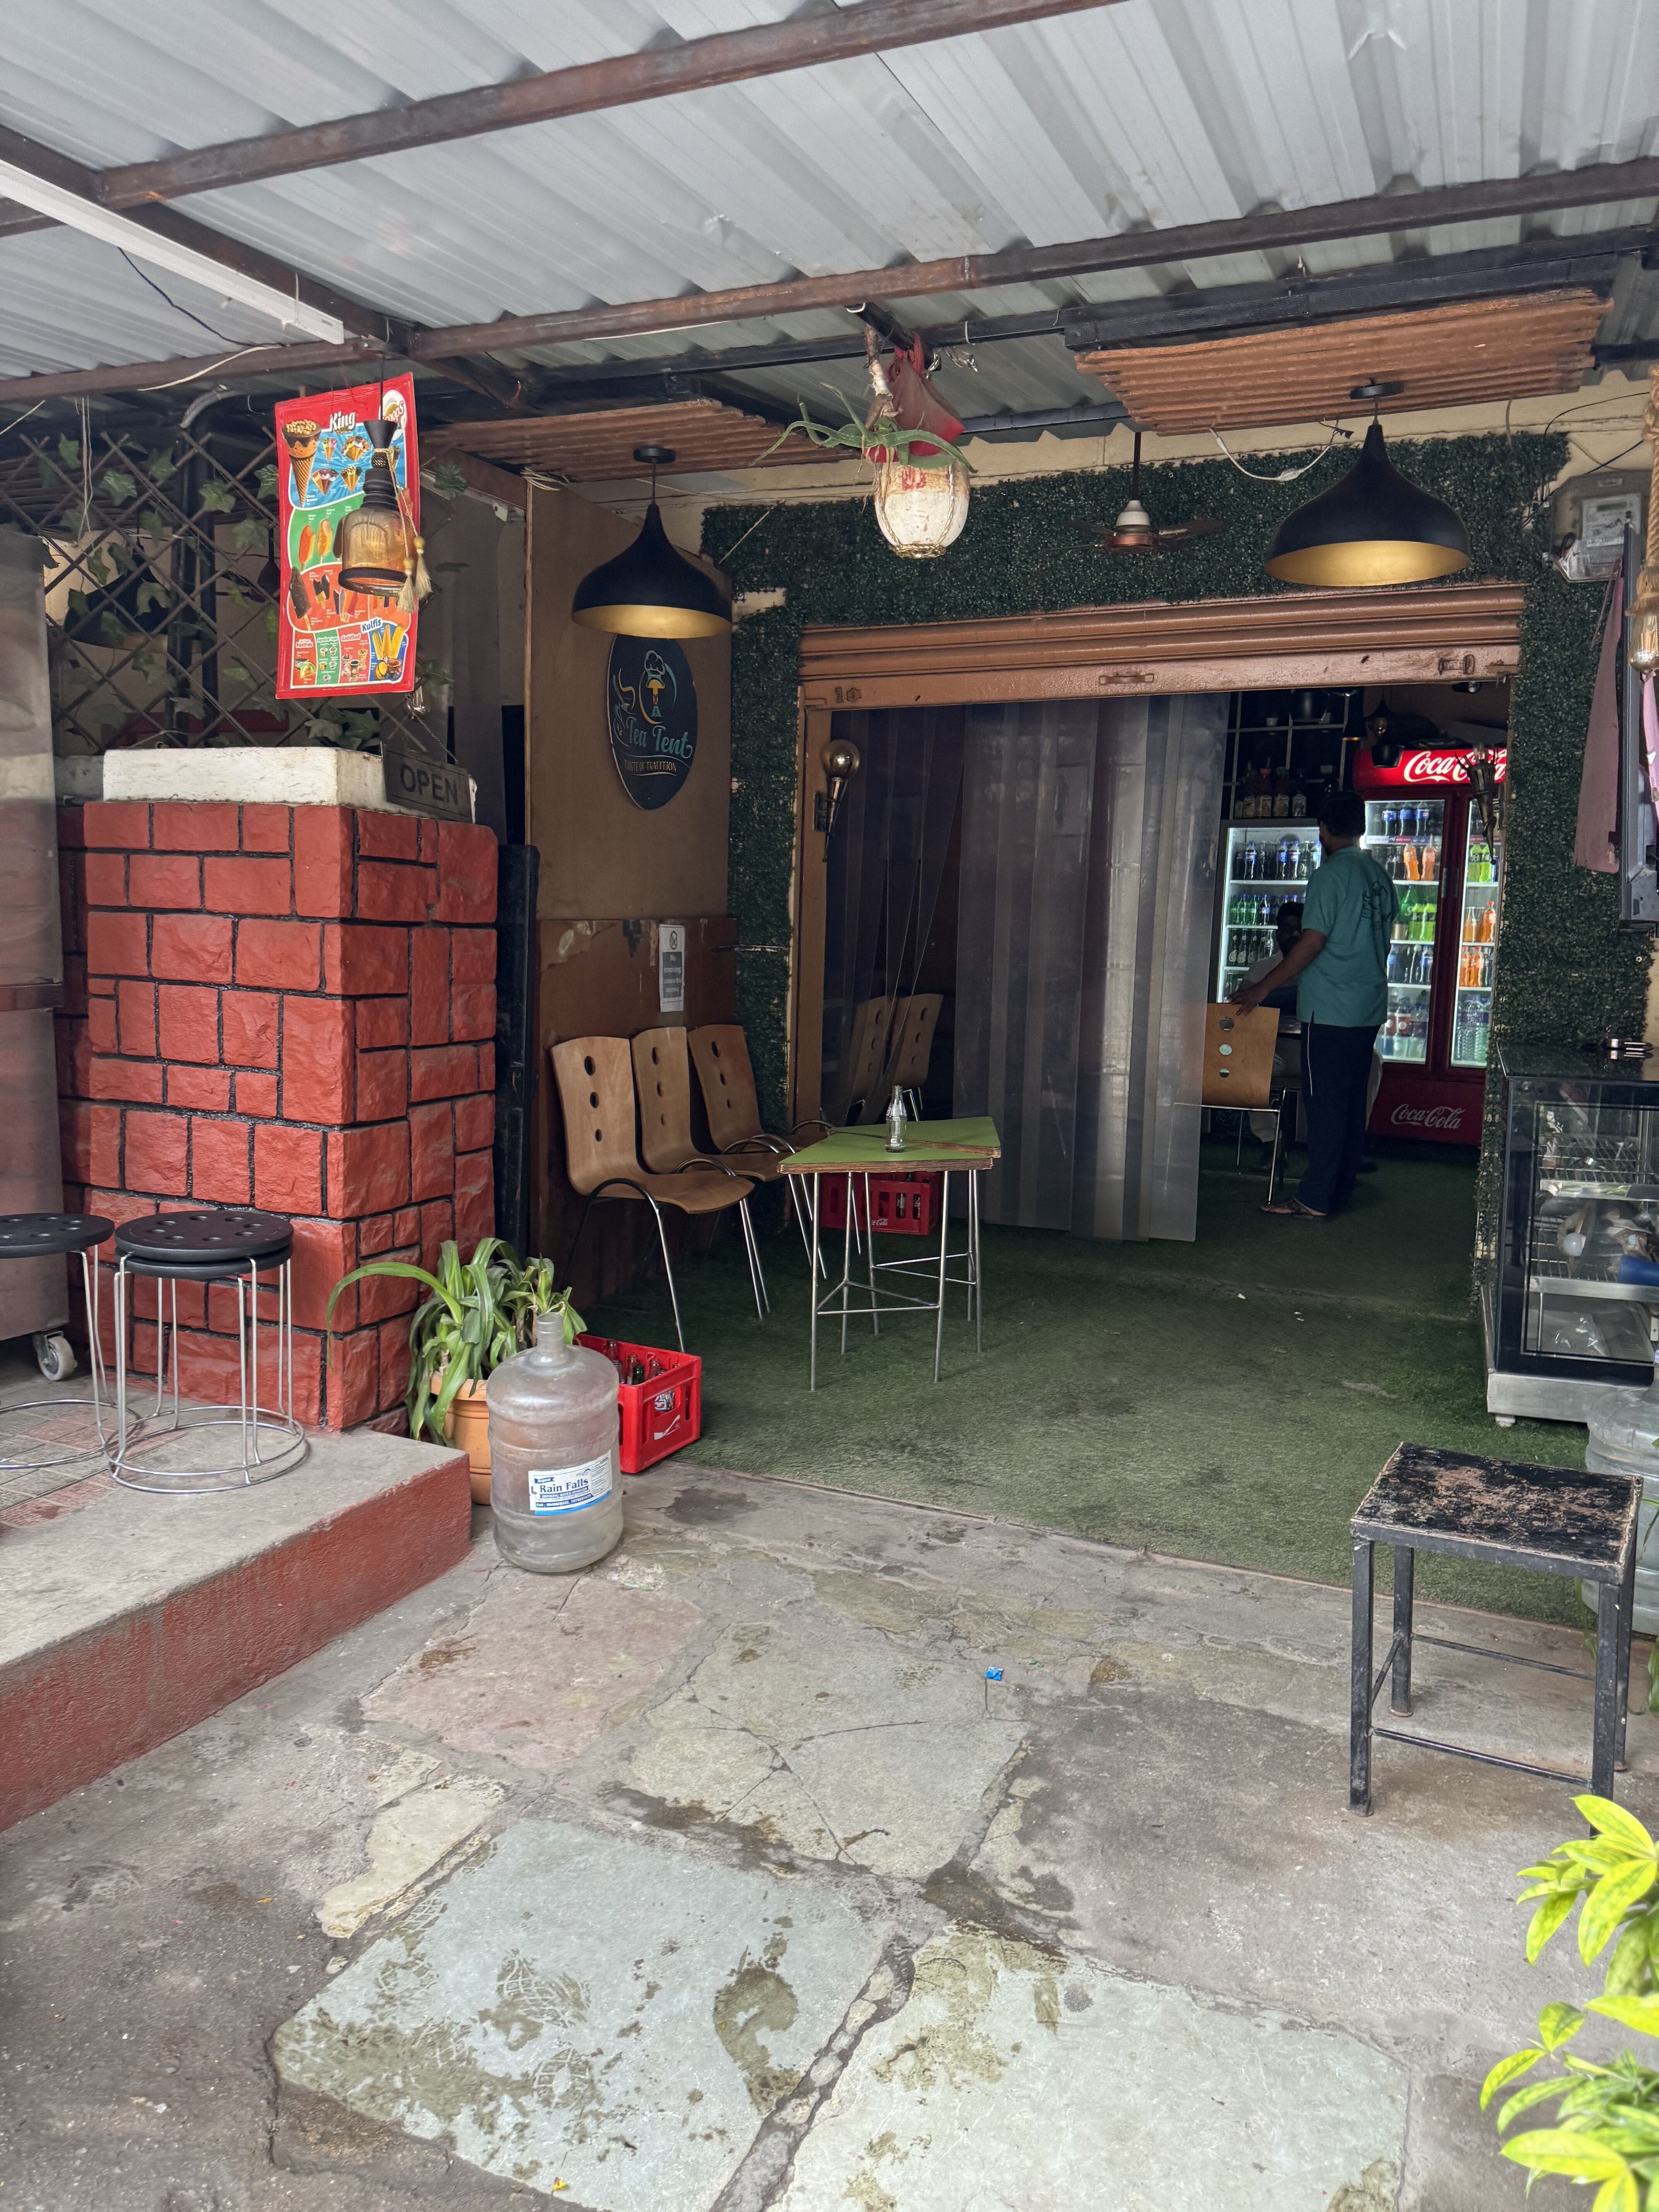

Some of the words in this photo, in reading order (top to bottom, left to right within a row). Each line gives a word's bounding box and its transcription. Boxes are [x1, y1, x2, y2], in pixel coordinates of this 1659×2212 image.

[330, 411, 356, 431] King
[361, 618, 381, 632] Kulfis
[626, 716, 647, 747] Tea
[653, 725, 693, 759] Tent
[400, 764, 458, 806] OPEN
[1391, 1103, 1466, 1130] Coca-Cola
[540, 1484, 562, 1493] Rain
[566, 1478, 588, 1490] Falls
